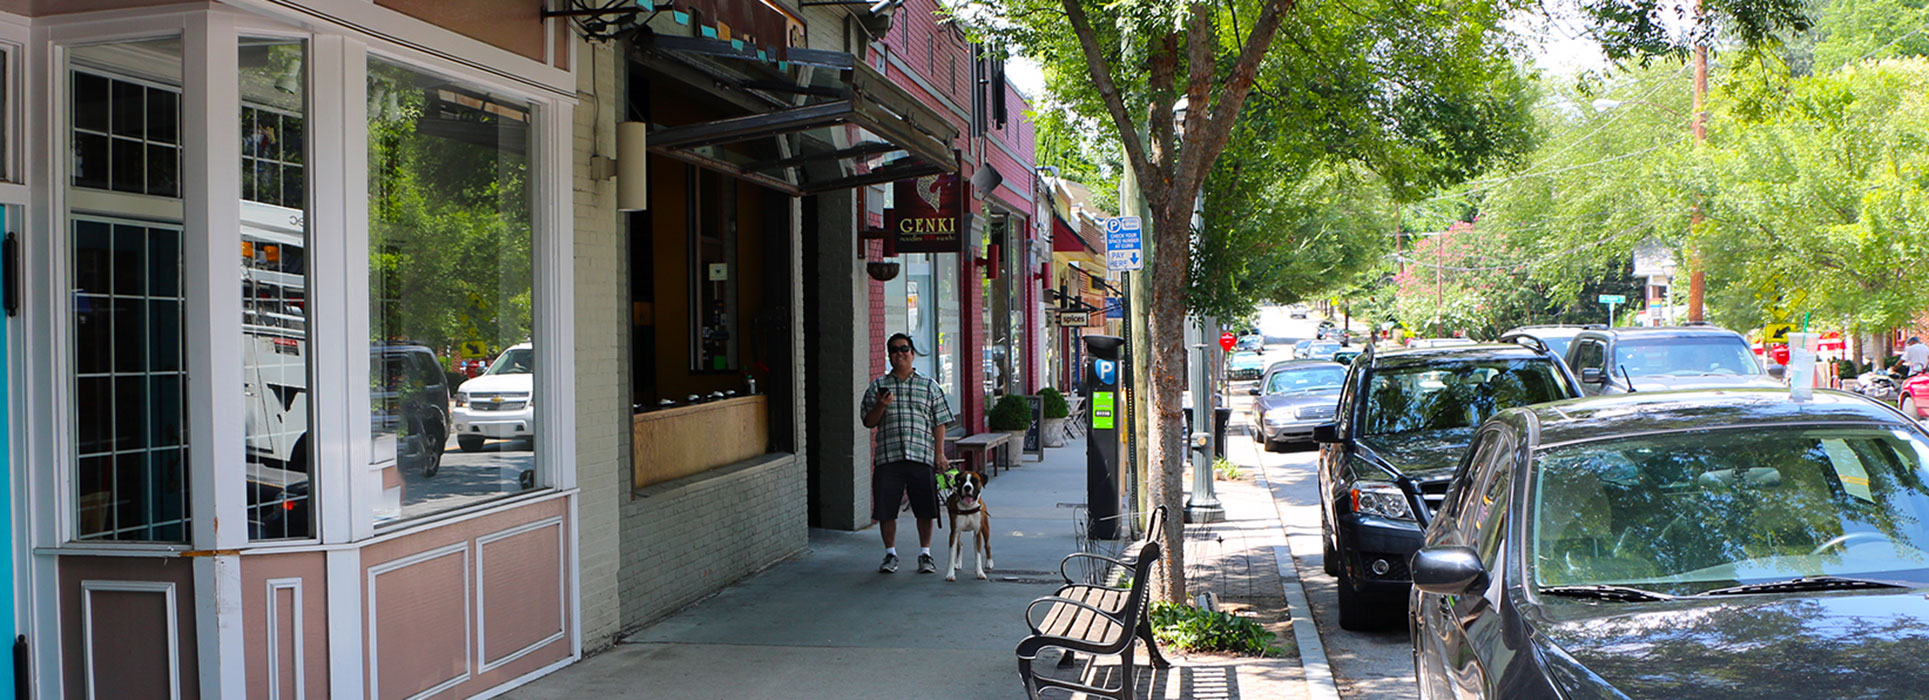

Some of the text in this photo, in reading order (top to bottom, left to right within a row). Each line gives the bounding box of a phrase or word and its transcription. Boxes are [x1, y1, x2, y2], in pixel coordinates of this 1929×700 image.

[899, 217, 955, 233] GENKI
[1110, 221, 1118, 231] P
[1063, 314, 1085, 324] spices
[1101, 361, 1113, 380] P
